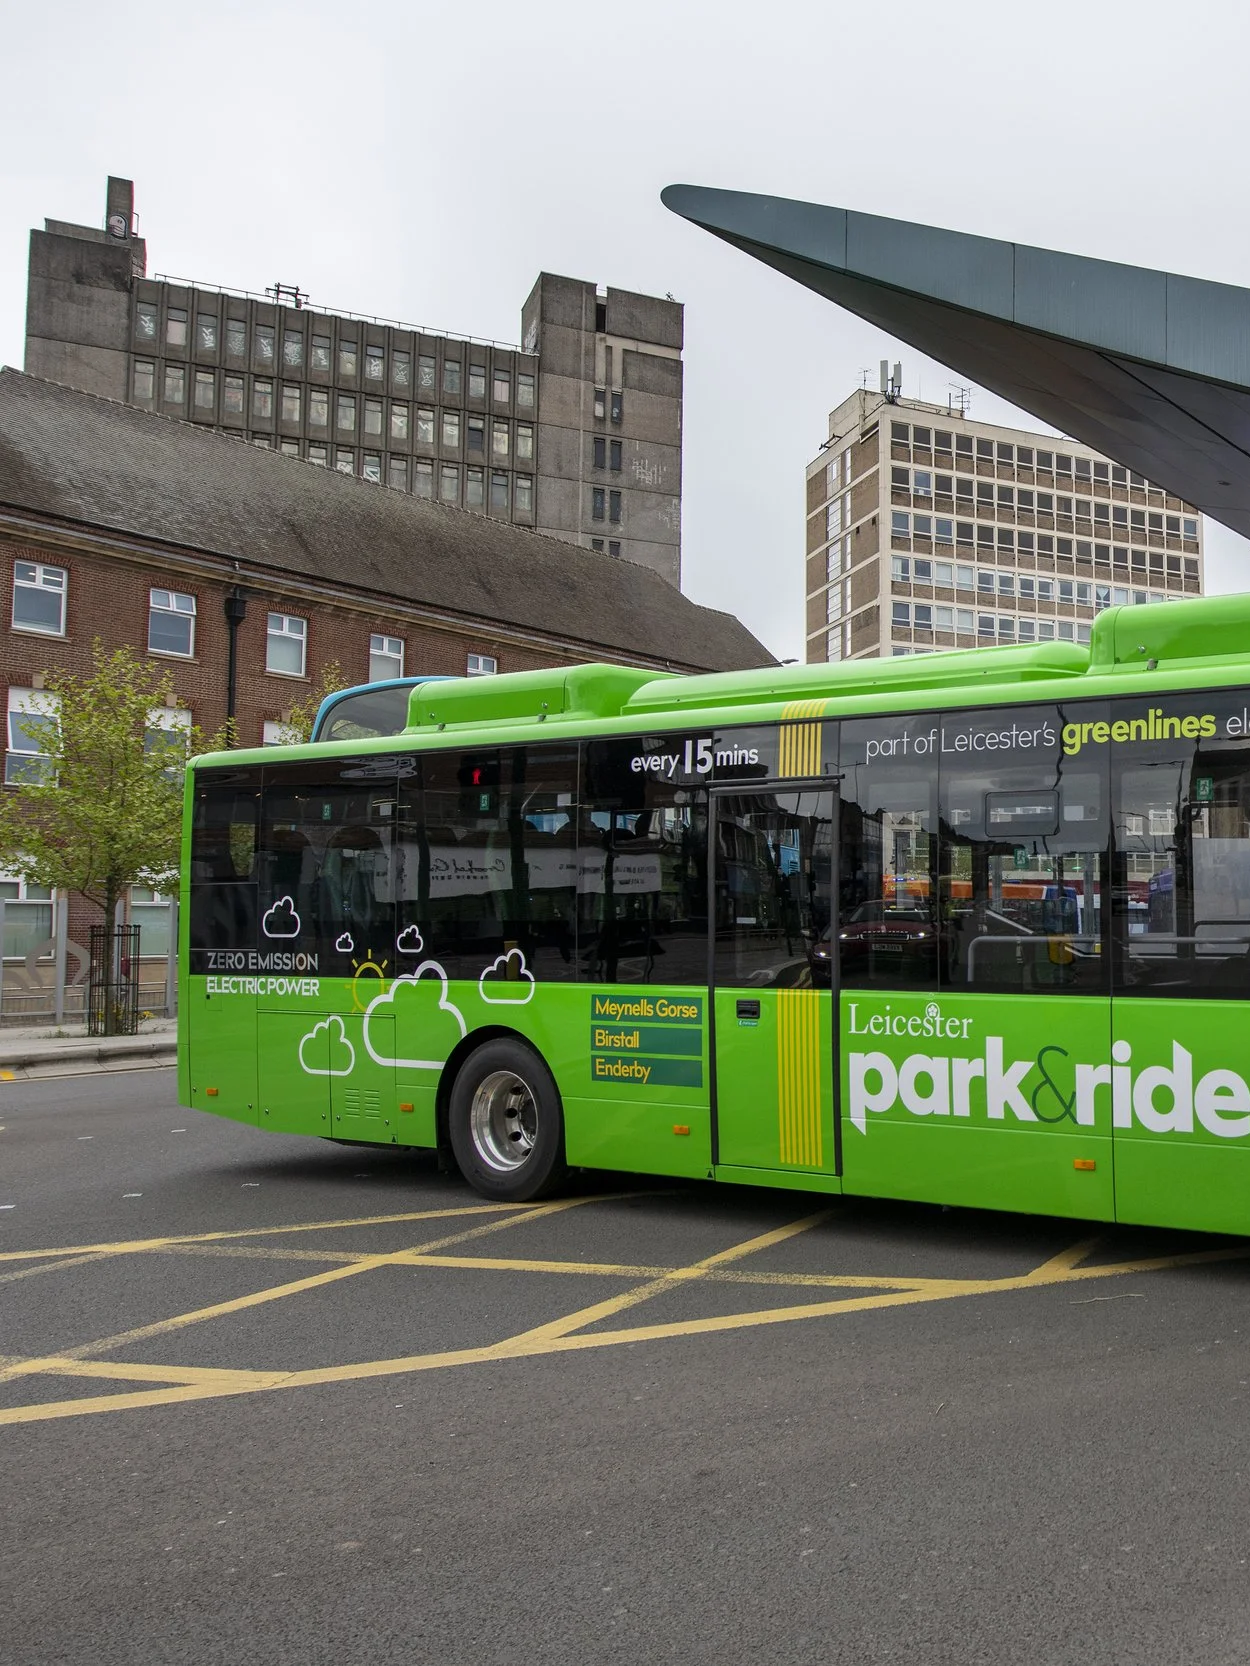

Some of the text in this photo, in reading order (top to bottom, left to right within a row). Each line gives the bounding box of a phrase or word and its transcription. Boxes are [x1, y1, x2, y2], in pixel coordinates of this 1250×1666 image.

[866, 730, 910, 765] part
[914, 728, 938, 754] of
[941, 721, 1056, 753] Leicester's
[1062, 708, 1217, 756] greenlines
[631, 738, 759, 778] every 15 mins
[207, 952, 318, 971] ZERO EMISSION
[206, 976, 320, 996] ELECTRIC POWER
[595, 997, 698, 1021] Meynells Gorse
[848, 1002, 973, 1039] Leicester
[595, 1029, 640, 1048] Birstall
[595, 1058, 651, 1084] Enderby
